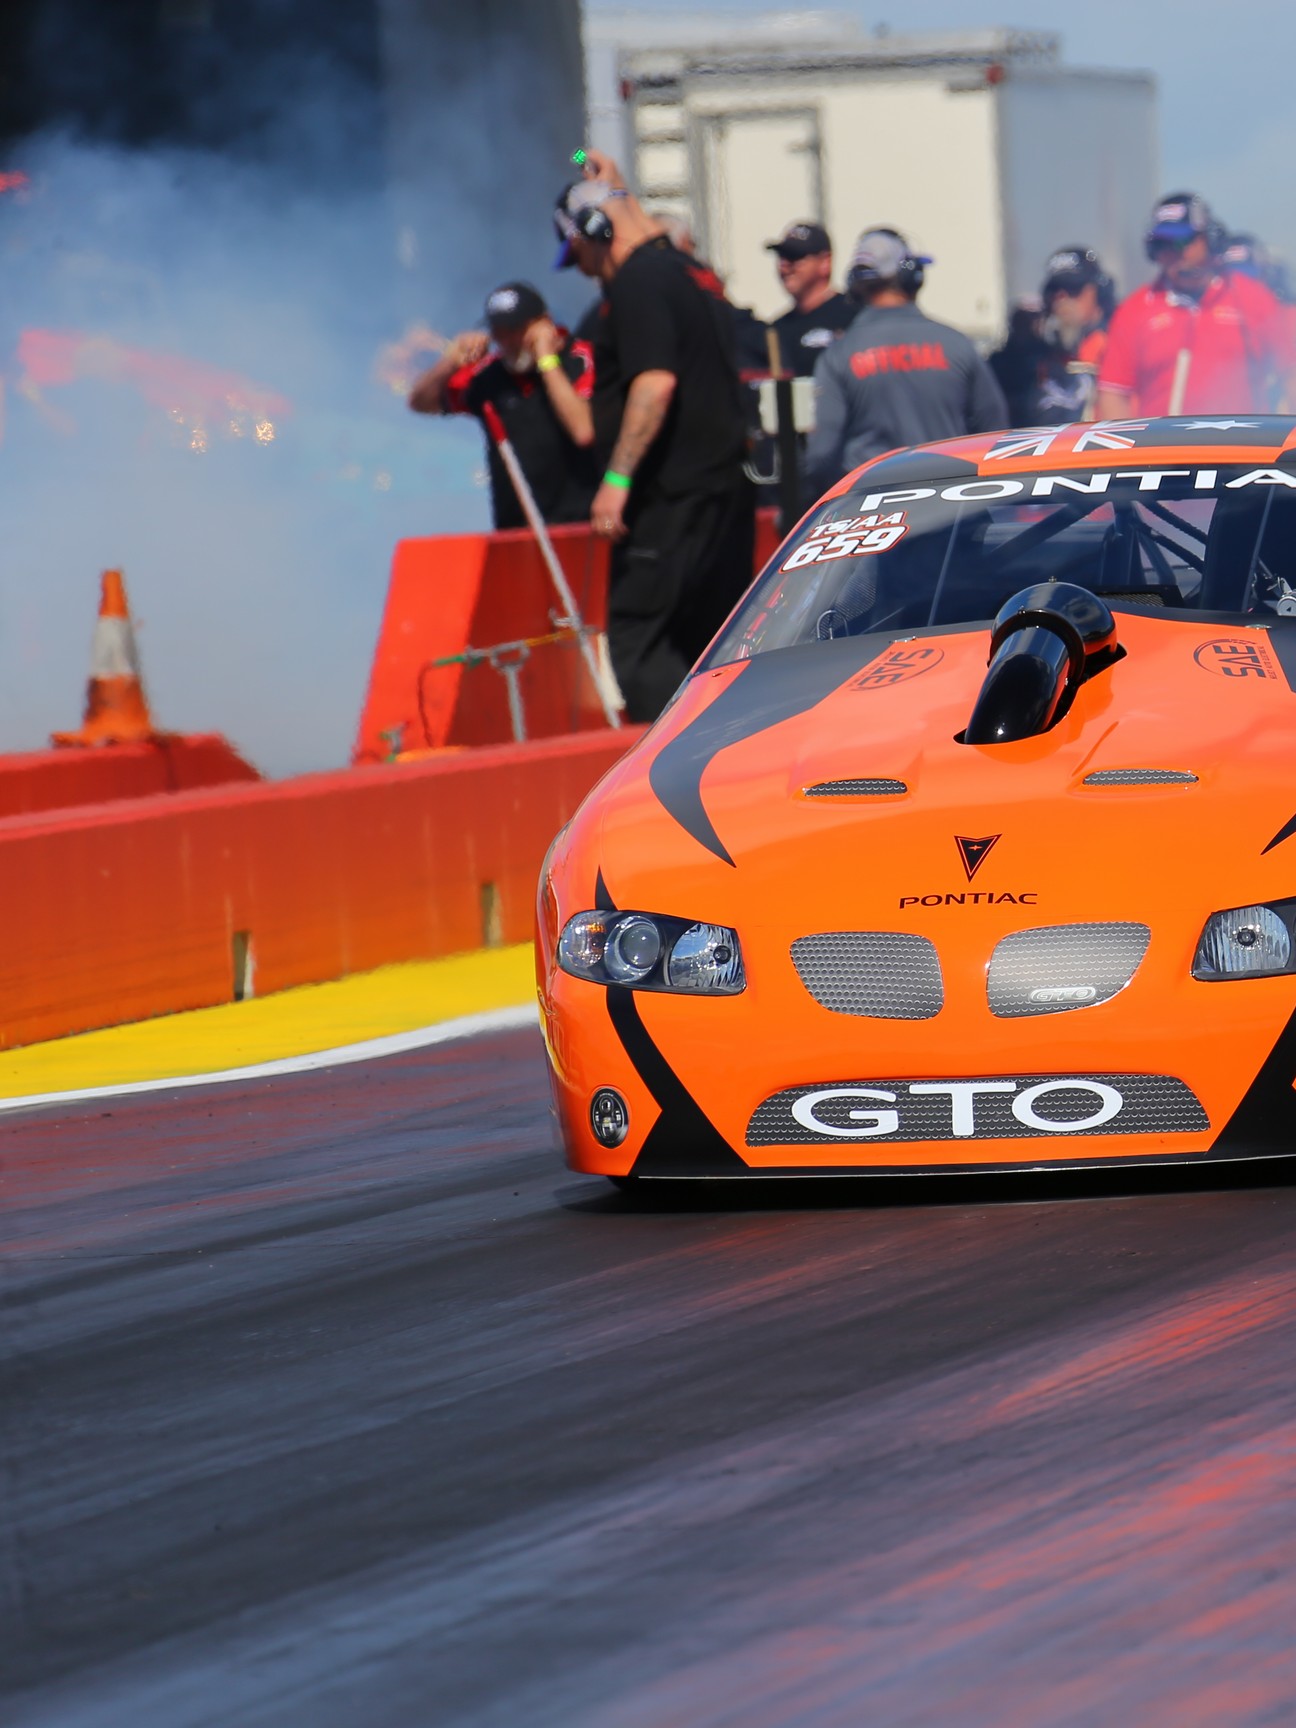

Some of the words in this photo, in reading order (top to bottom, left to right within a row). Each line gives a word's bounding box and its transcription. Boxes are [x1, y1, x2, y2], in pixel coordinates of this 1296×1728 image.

[809, 511, 906, 540] TS/AA
[780, 525, 908, 572] 659
[899, 892, 1038, 910] PONTIAC
[1034, 986, 1093, 1003] GTO
[791, 1079, 1124, 1137] GTO
